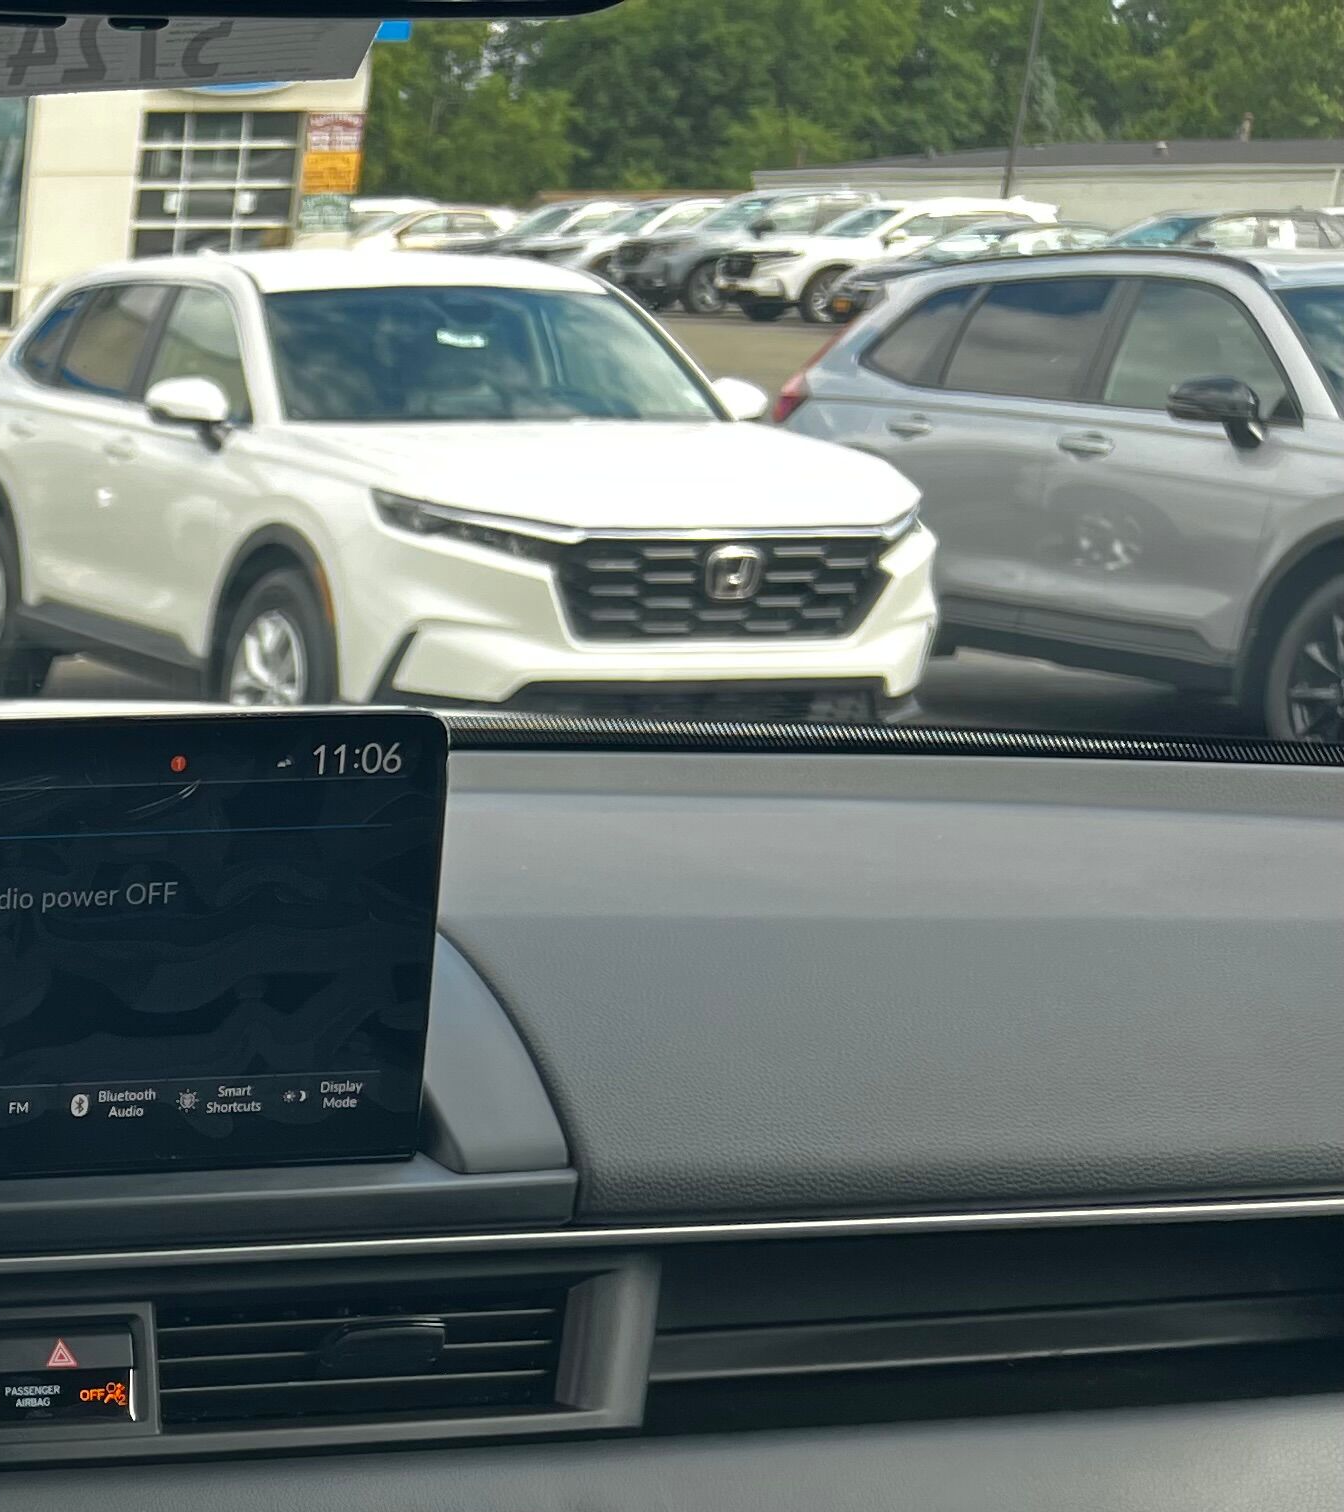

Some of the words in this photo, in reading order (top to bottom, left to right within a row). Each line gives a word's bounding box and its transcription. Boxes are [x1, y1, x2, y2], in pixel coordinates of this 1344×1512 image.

[312, 742, 403, 776] 11:06
[41, 887, 119, 914] power
[126, 881, 178, 905] OFF
[97, 1088, 157, 1104] Bluetooth
[217, 1084, 252, 1099] Smart
[320, 1080, 363, 1097] Display
[9, 1101, 29, 1115] FM
[205, 1099, 261, 1115] Shortcuts
[322, 1095, 357, 1110] Mode
[107, 1104, 144, 1118] Audio
[4, 1385, 61, 1397] PASSENGER
[79, 1388, 106, 1402] OFF
[15, 1397, 51, 1408] AIRBAG
